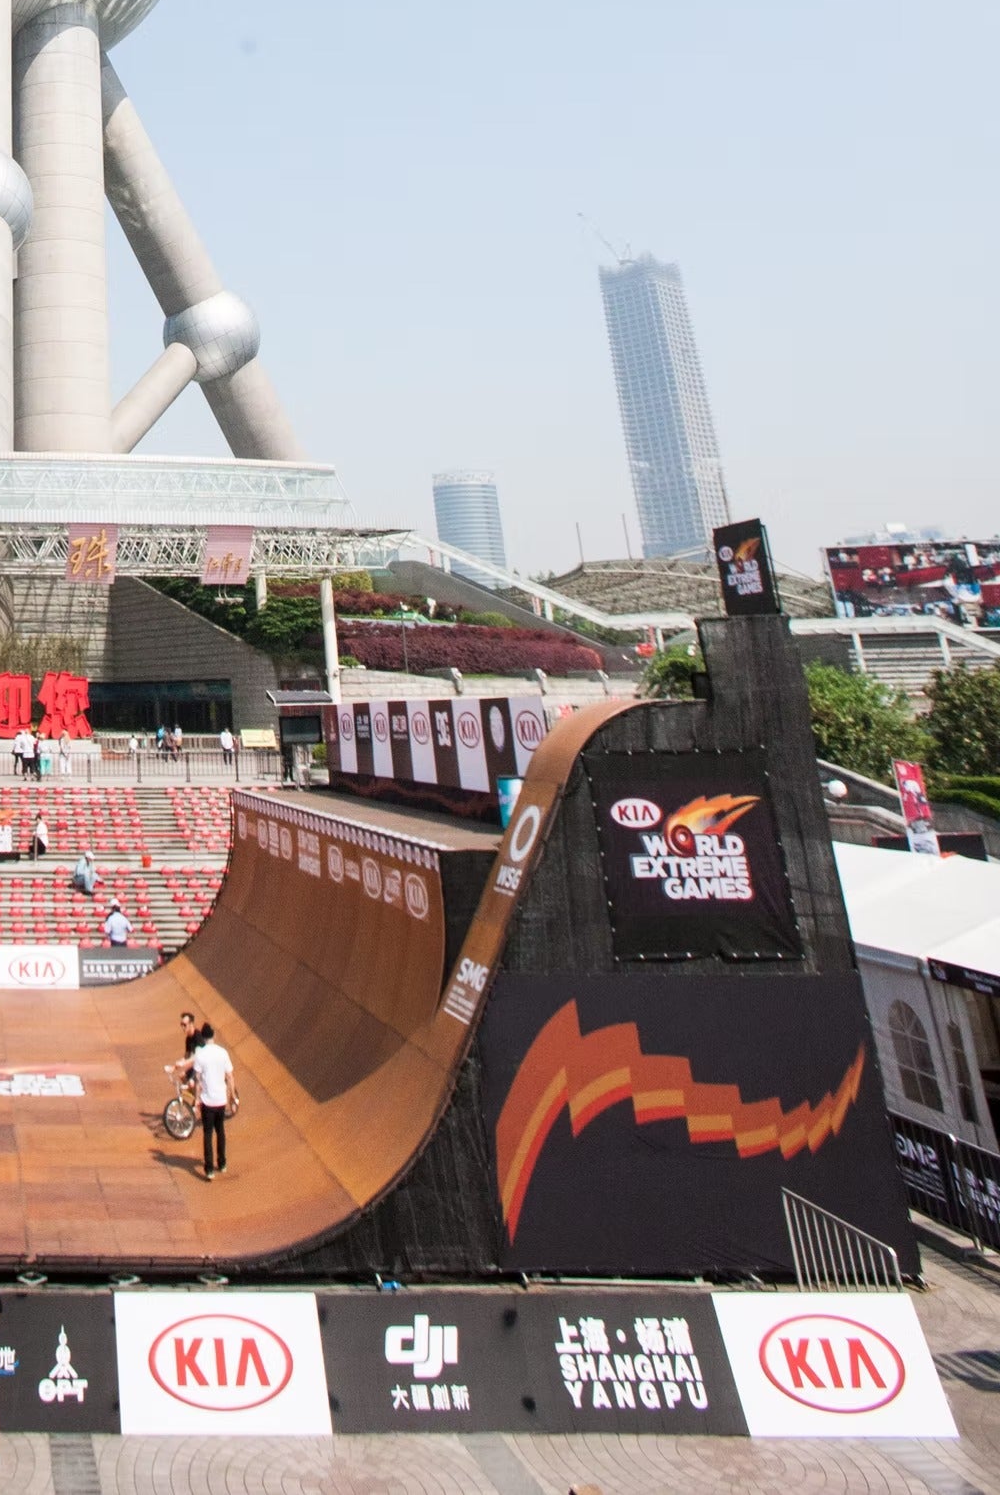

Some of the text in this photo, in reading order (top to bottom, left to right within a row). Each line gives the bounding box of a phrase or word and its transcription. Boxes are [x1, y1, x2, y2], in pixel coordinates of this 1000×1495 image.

[459, 720, 477, 739] KIA
[519, 720, 542, 742] KIA
[617, 805, 655, 821] KIA
[641, 833, 745, 856] WORLD
[631, 855, 750, 878] EXTREME
[663, 877, 753, 900] GAMES
[19, 961, 56, 978] KIA
[456, 958, 489, 992] SMG
[173, 1338, 270, 1386] KIA
[559, 1353, 703, 1382] SHANGHAI
[777, 1337, 887, 1389] KIA
[564, 1381, 708, 1409] YANGPU
